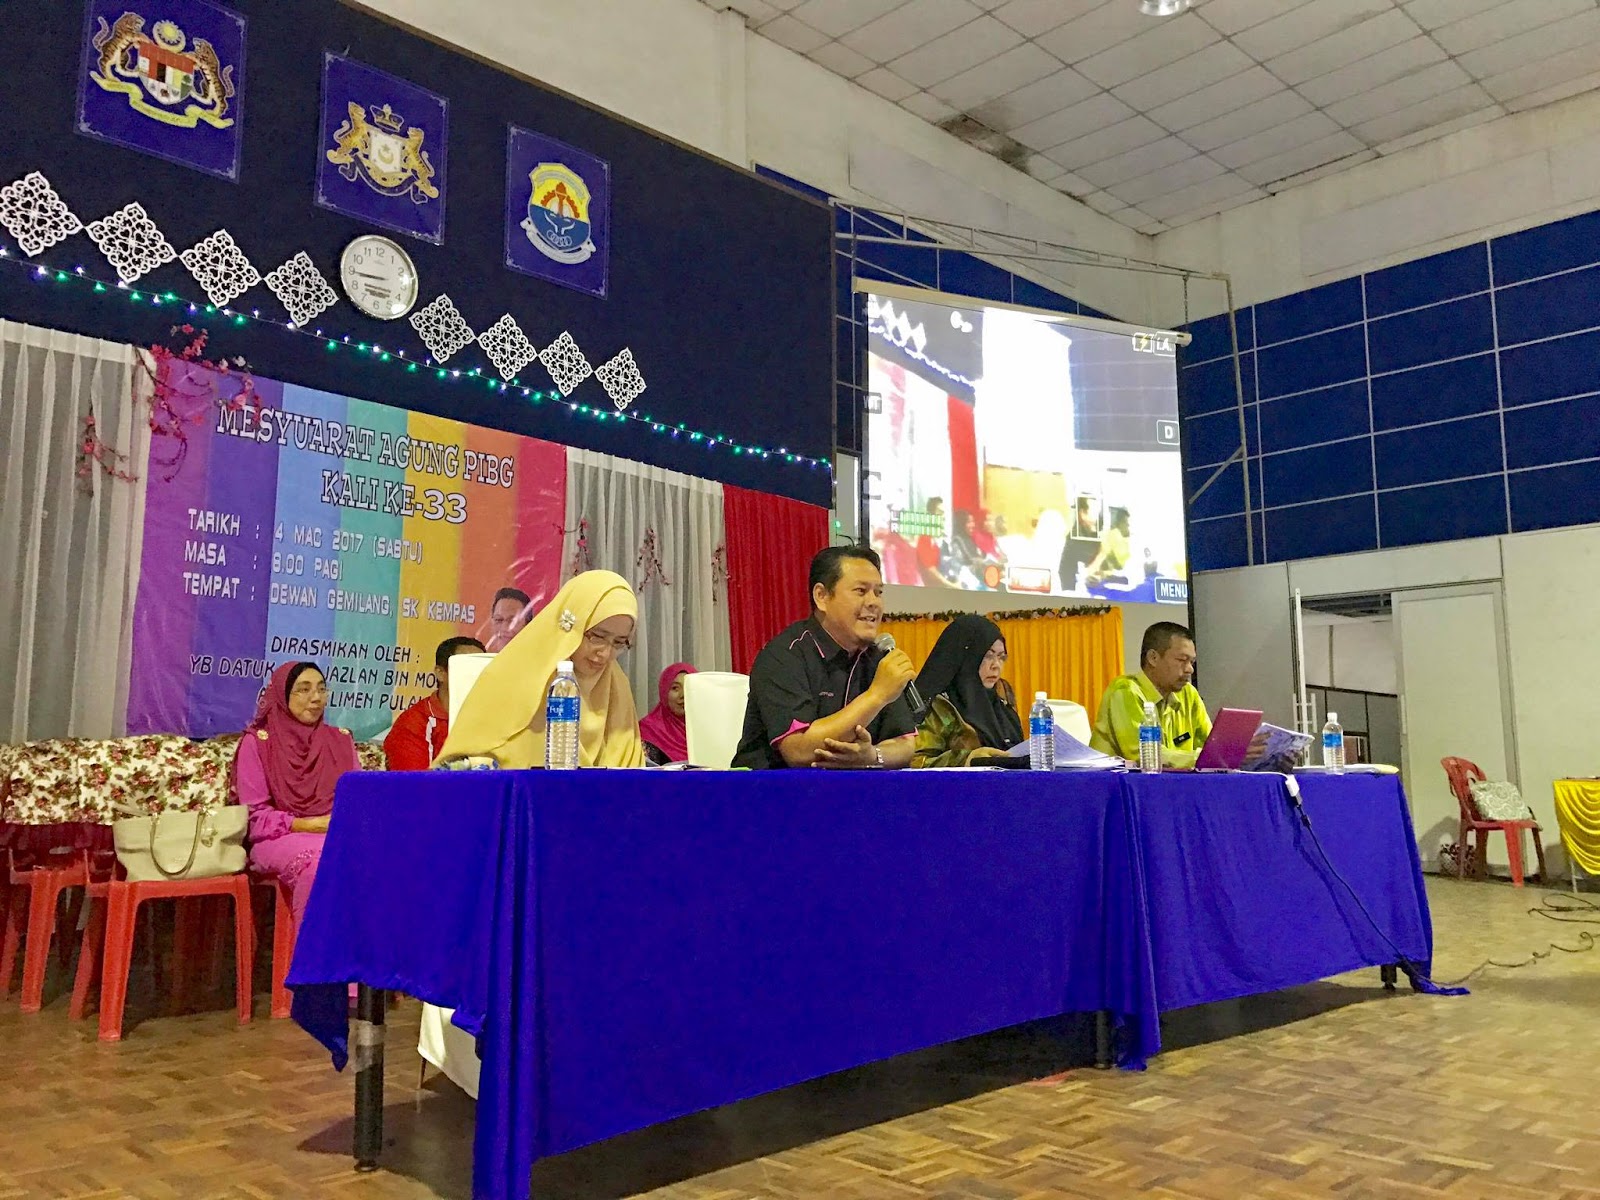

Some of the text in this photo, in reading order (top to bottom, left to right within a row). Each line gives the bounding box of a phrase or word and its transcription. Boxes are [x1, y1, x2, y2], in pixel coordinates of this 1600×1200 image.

[353, 254, 363, 264] 10
[364, 247, 372, 257] 11
[376, 247, 385, 257] 12
[398, 267, 404, 275] 2
[351, 280, 359, 290] 8
[361, 293, 367, 301] 7
[373, 300, 380, 309] 6
[395, 293, 401, 301] 4
[1164, 425, 1173, 439] D
[216, 404, 514, 488] MESYUARAT AGUNG PIBG
[321, 469, 467, 524] KALI KE-33
[188, 508, 241, 536] TARIKH
[275, 522, 284, 543] 4
[294, 525, 322, 548] MAC
[332, 530, 363, 553] 2017
[373, 535, 423, 565] (SABTU)
[184, 540, 226, 566] MASA
[272, 552, 304, 576] 8.00
[314, 557, 343, 580] PAGI
[183, 571, 240, 600] TEMPAT
[270, 582, 317, 608] DEWAN
[327, 588, 394, 617] GEMILANG,
[402, 598, 419, 619] SK
[427, 600, 476, 624] KEMPAS
[1160, 582, 1188, 598] MENU
[271, 635, 369, 659] DIRASMIKAN
[374, 645, 411, 663] OLEH
[190, 655, 438, 689] YB DATUK JAZLAN BIN MO
[330, 691, 374, 709] LIMEN
